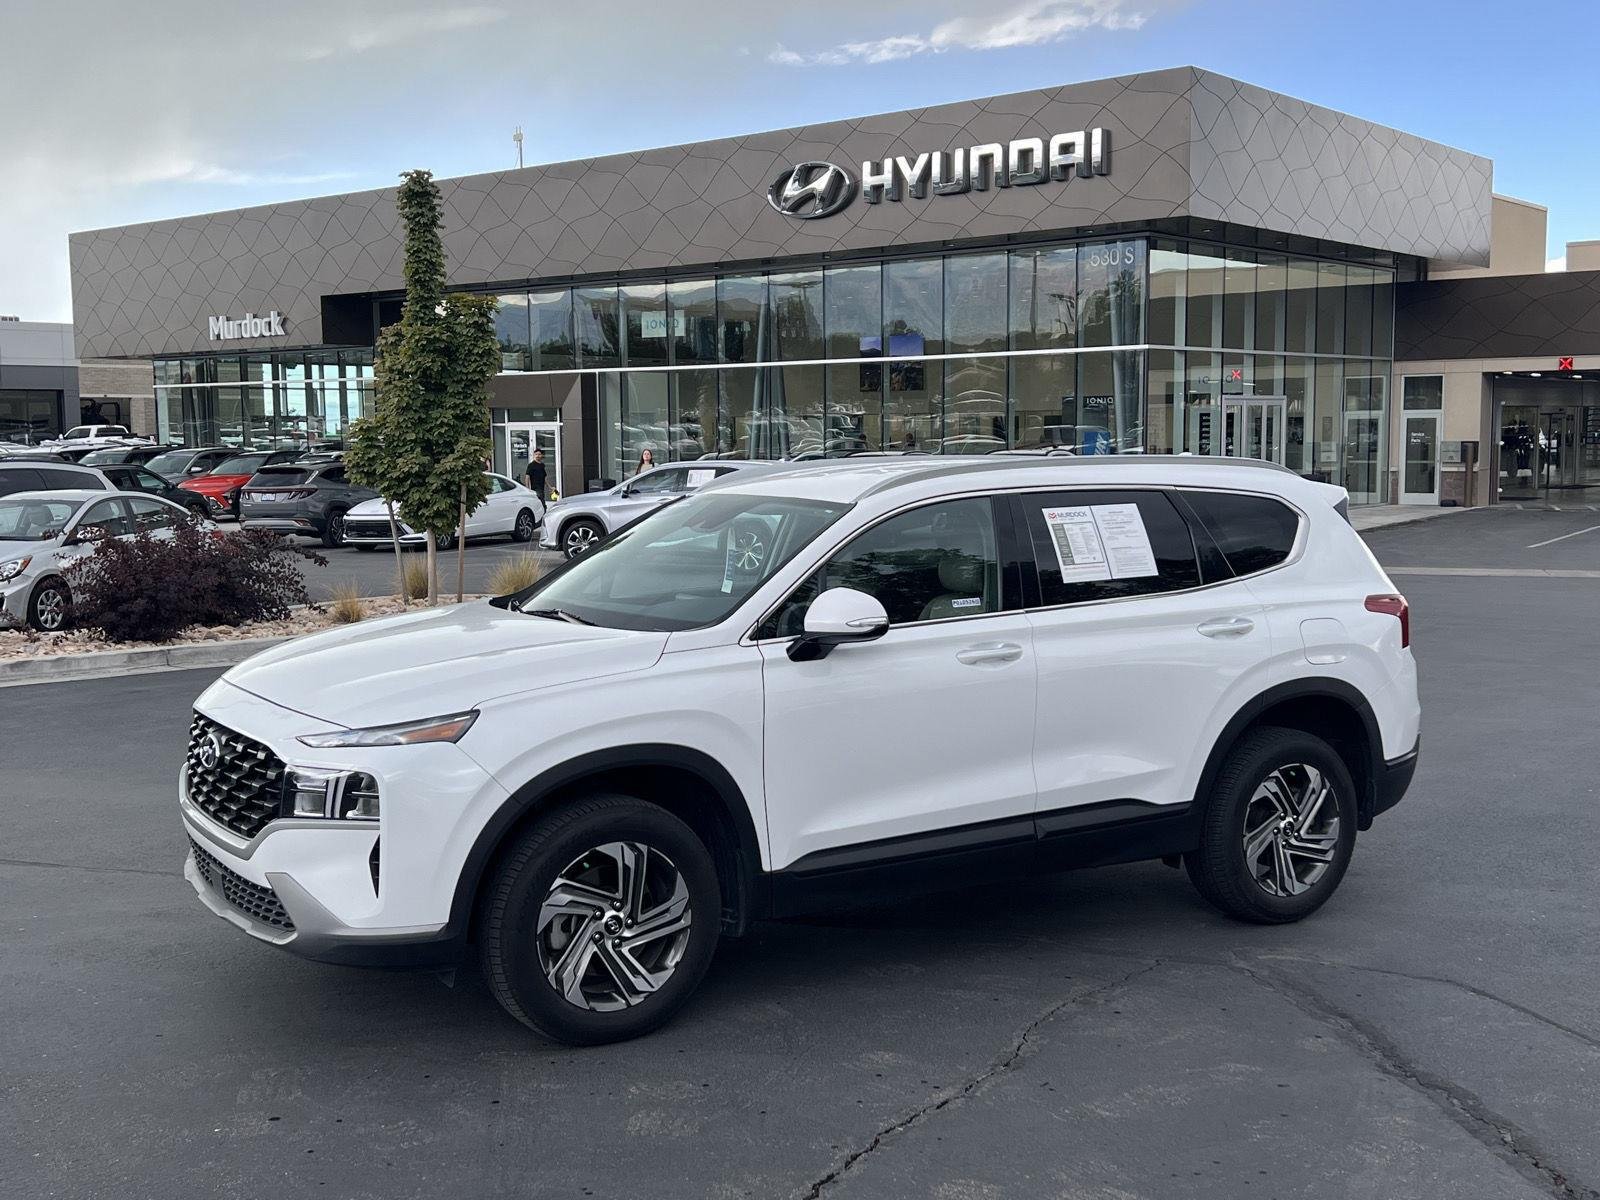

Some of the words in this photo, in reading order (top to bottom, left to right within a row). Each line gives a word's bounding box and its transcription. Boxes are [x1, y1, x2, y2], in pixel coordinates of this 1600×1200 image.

[862, 127, 1111, 204] HYUNDAI
[1124, 246, 1135, 264] S
[208, 310, 286, 341] Murdock
[646, 318, 680, 330] IONQ
